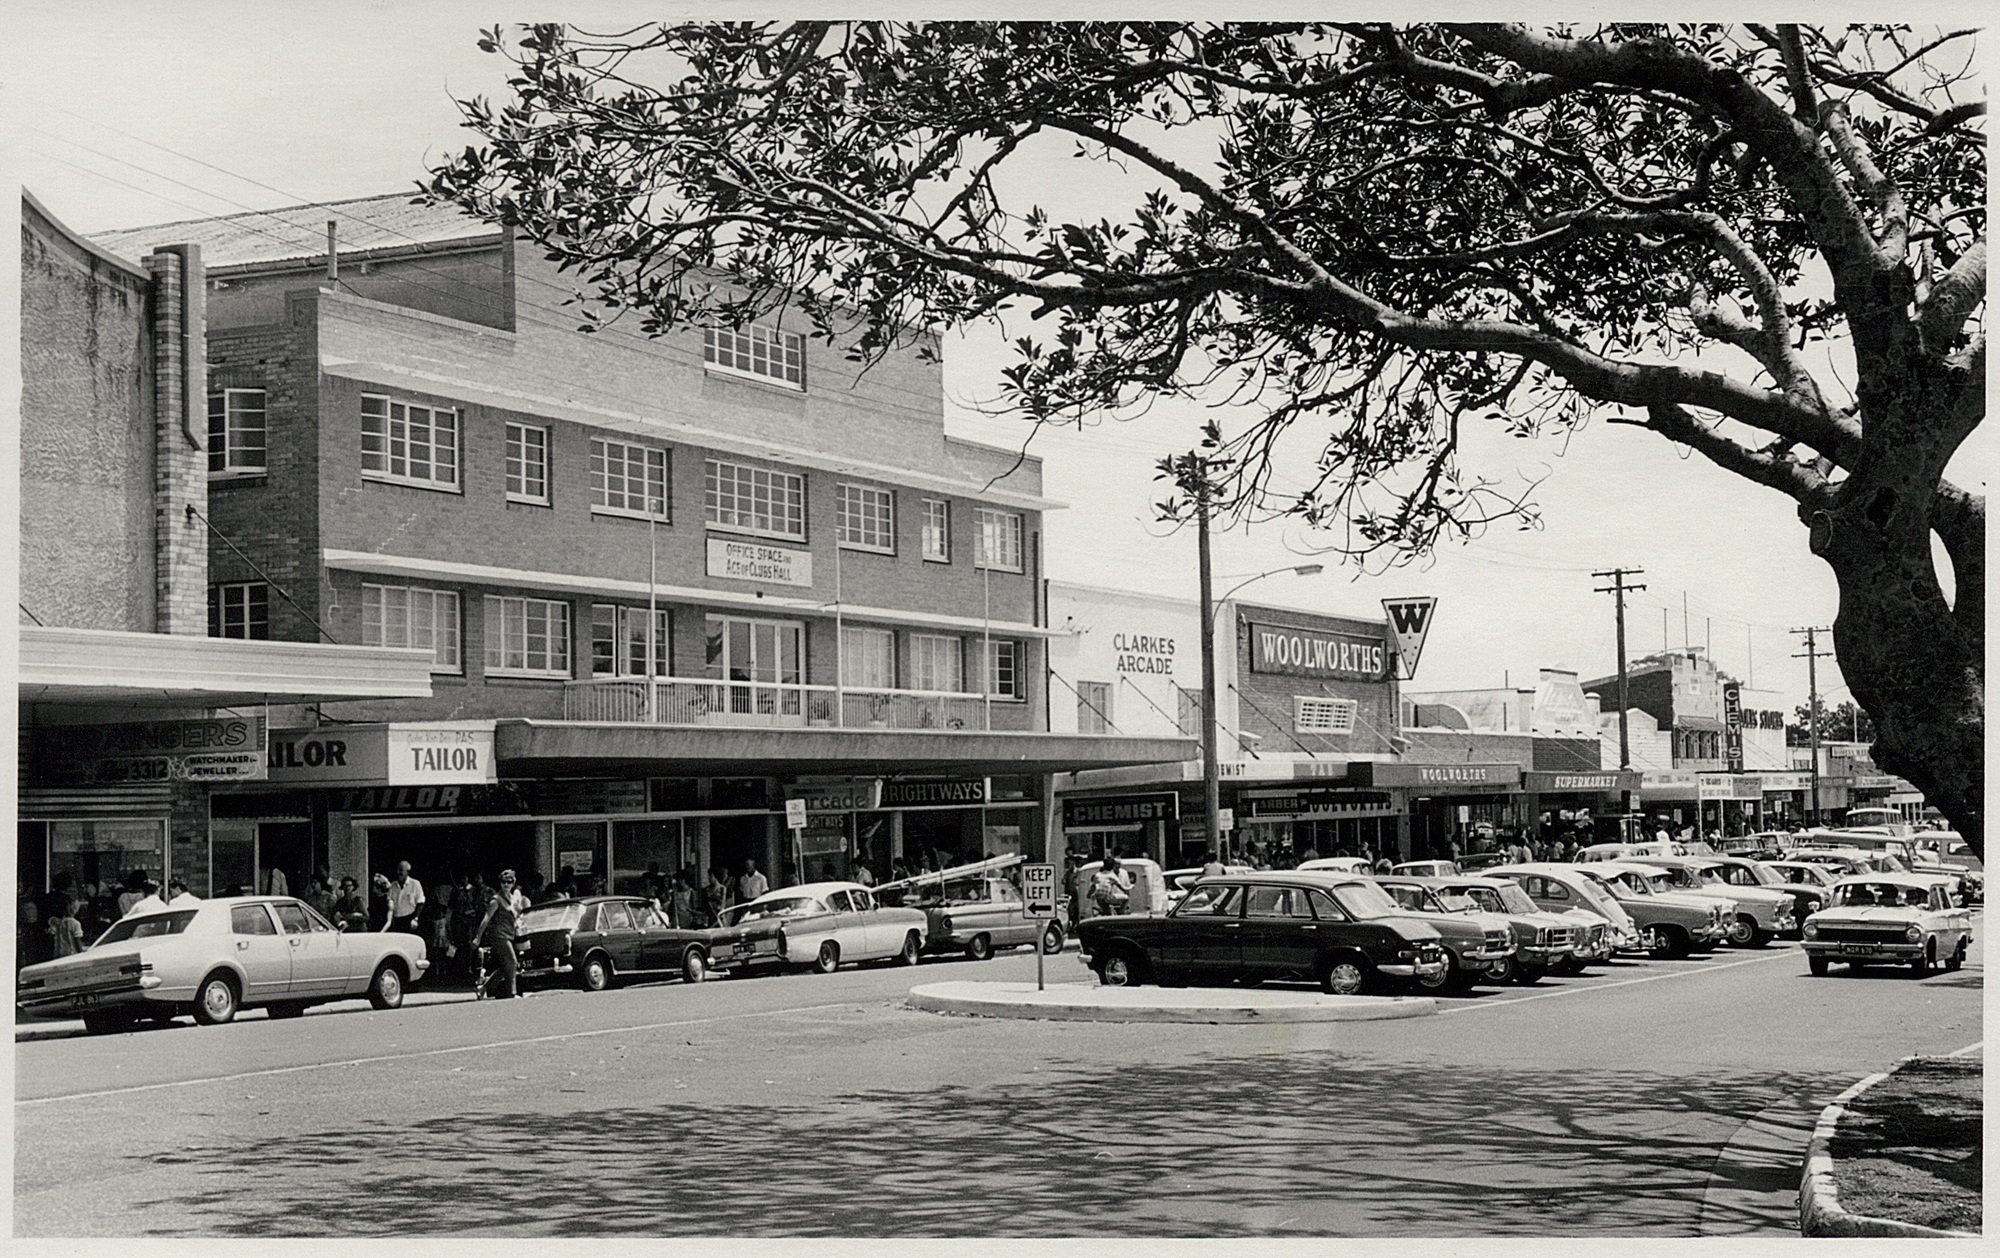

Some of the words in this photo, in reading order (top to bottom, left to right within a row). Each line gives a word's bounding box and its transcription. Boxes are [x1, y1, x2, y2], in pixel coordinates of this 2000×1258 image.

[726, 543, 755, 559] OFFICE
[757, 547, 783, 563] SPACE
[773, 564, 792, 581] HALL
[1388, 603, 1431, 634] W
[1261, 632, 1383, 674] WOOLWORTHS
[1116, 655, 1173, 675] ARCADE
[1725, 689, 1742, 770] CHEMIST
[189, 756, 249, 765] WATCHMAKER
[411, 747, 478, 771] TAILOR
[1422, 768, 1486, 781] WOOLWORTHS
[1554, 776, 1618, 788] SUPERMARKET
[342, 786, 461, 810] TAILOR
[806, 788, 867, 809] rcade
[1073, 802, 1166, 821] CHEMIST
[1025, 868, 1052, 882] KEEP
[1026, 886, 1051, 900] LEFT
